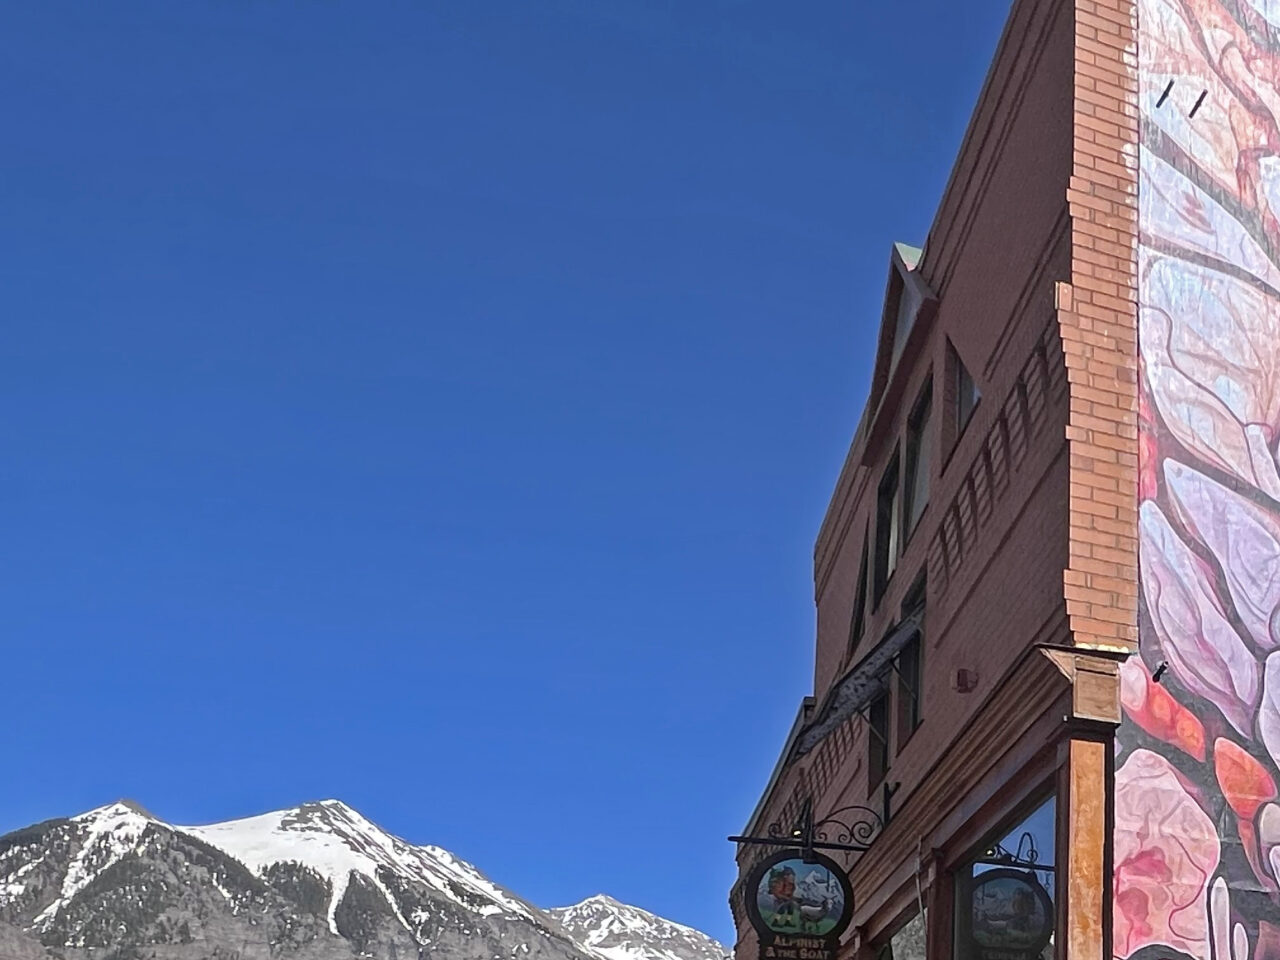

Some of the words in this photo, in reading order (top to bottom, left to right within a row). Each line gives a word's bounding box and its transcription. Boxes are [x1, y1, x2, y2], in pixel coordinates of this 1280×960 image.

[765, 946, 776, 958] &
[777, 949, 797, 958] THE
[800, 948, 831, 959] GOAT
